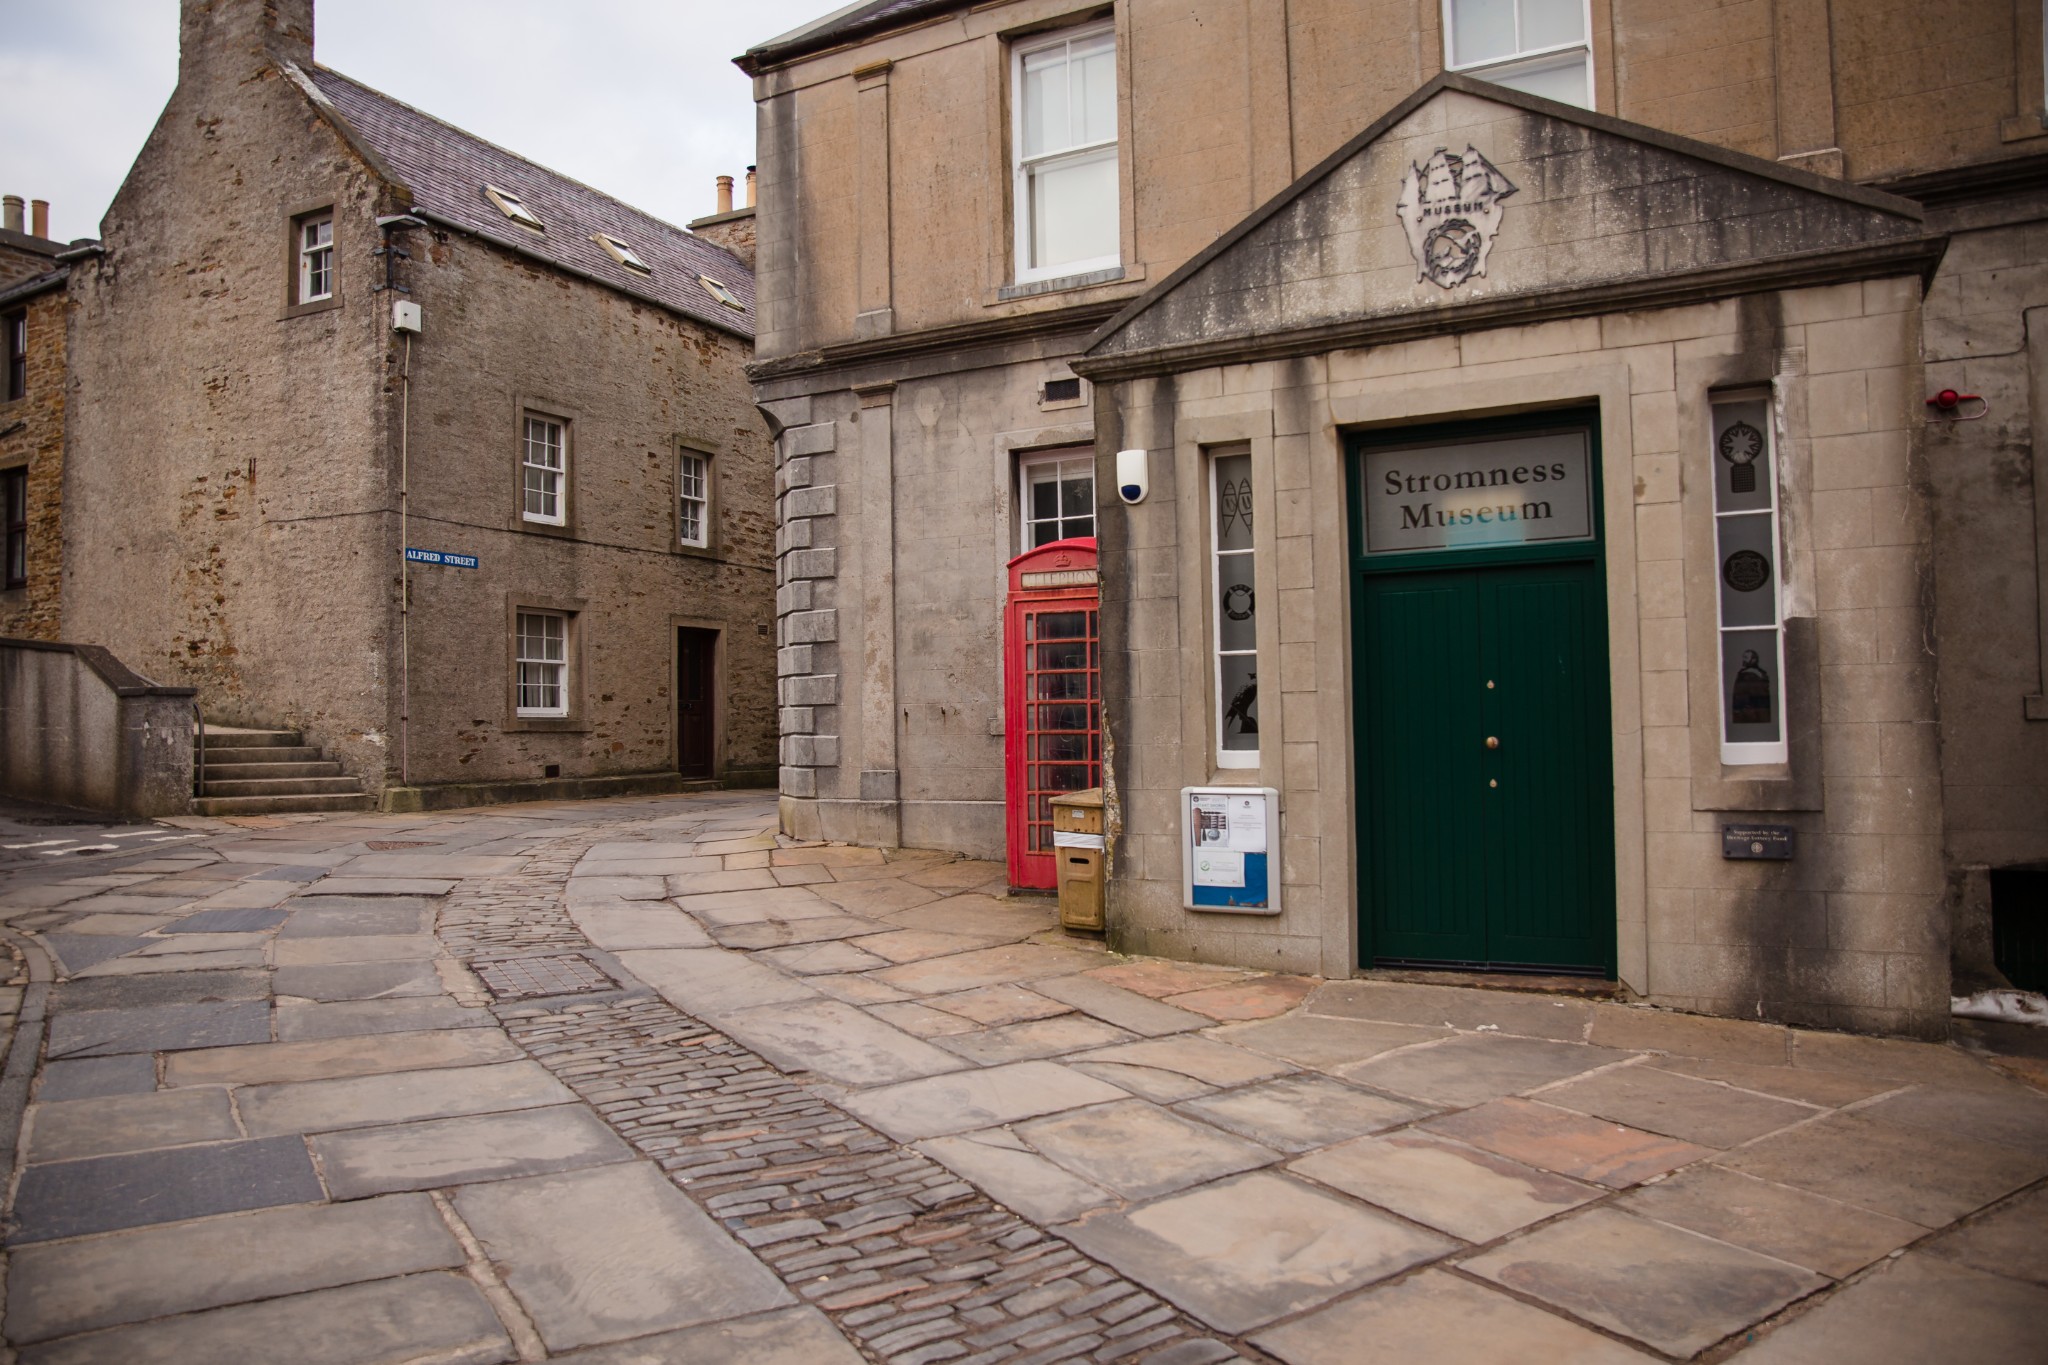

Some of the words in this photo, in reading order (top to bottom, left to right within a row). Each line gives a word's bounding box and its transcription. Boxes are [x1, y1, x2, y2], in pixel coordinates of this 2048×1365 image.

[1423, 202, 1483, 216] MUSEUM
[1384, 462, 1566, 496] Stromness
[1400, 499, 1553, 530] Museum
[407, 550, 440, 562] ALFRED
[444, 554, 476, 567] STREET
[1024, 570, 1096, 586] TELEPHON
